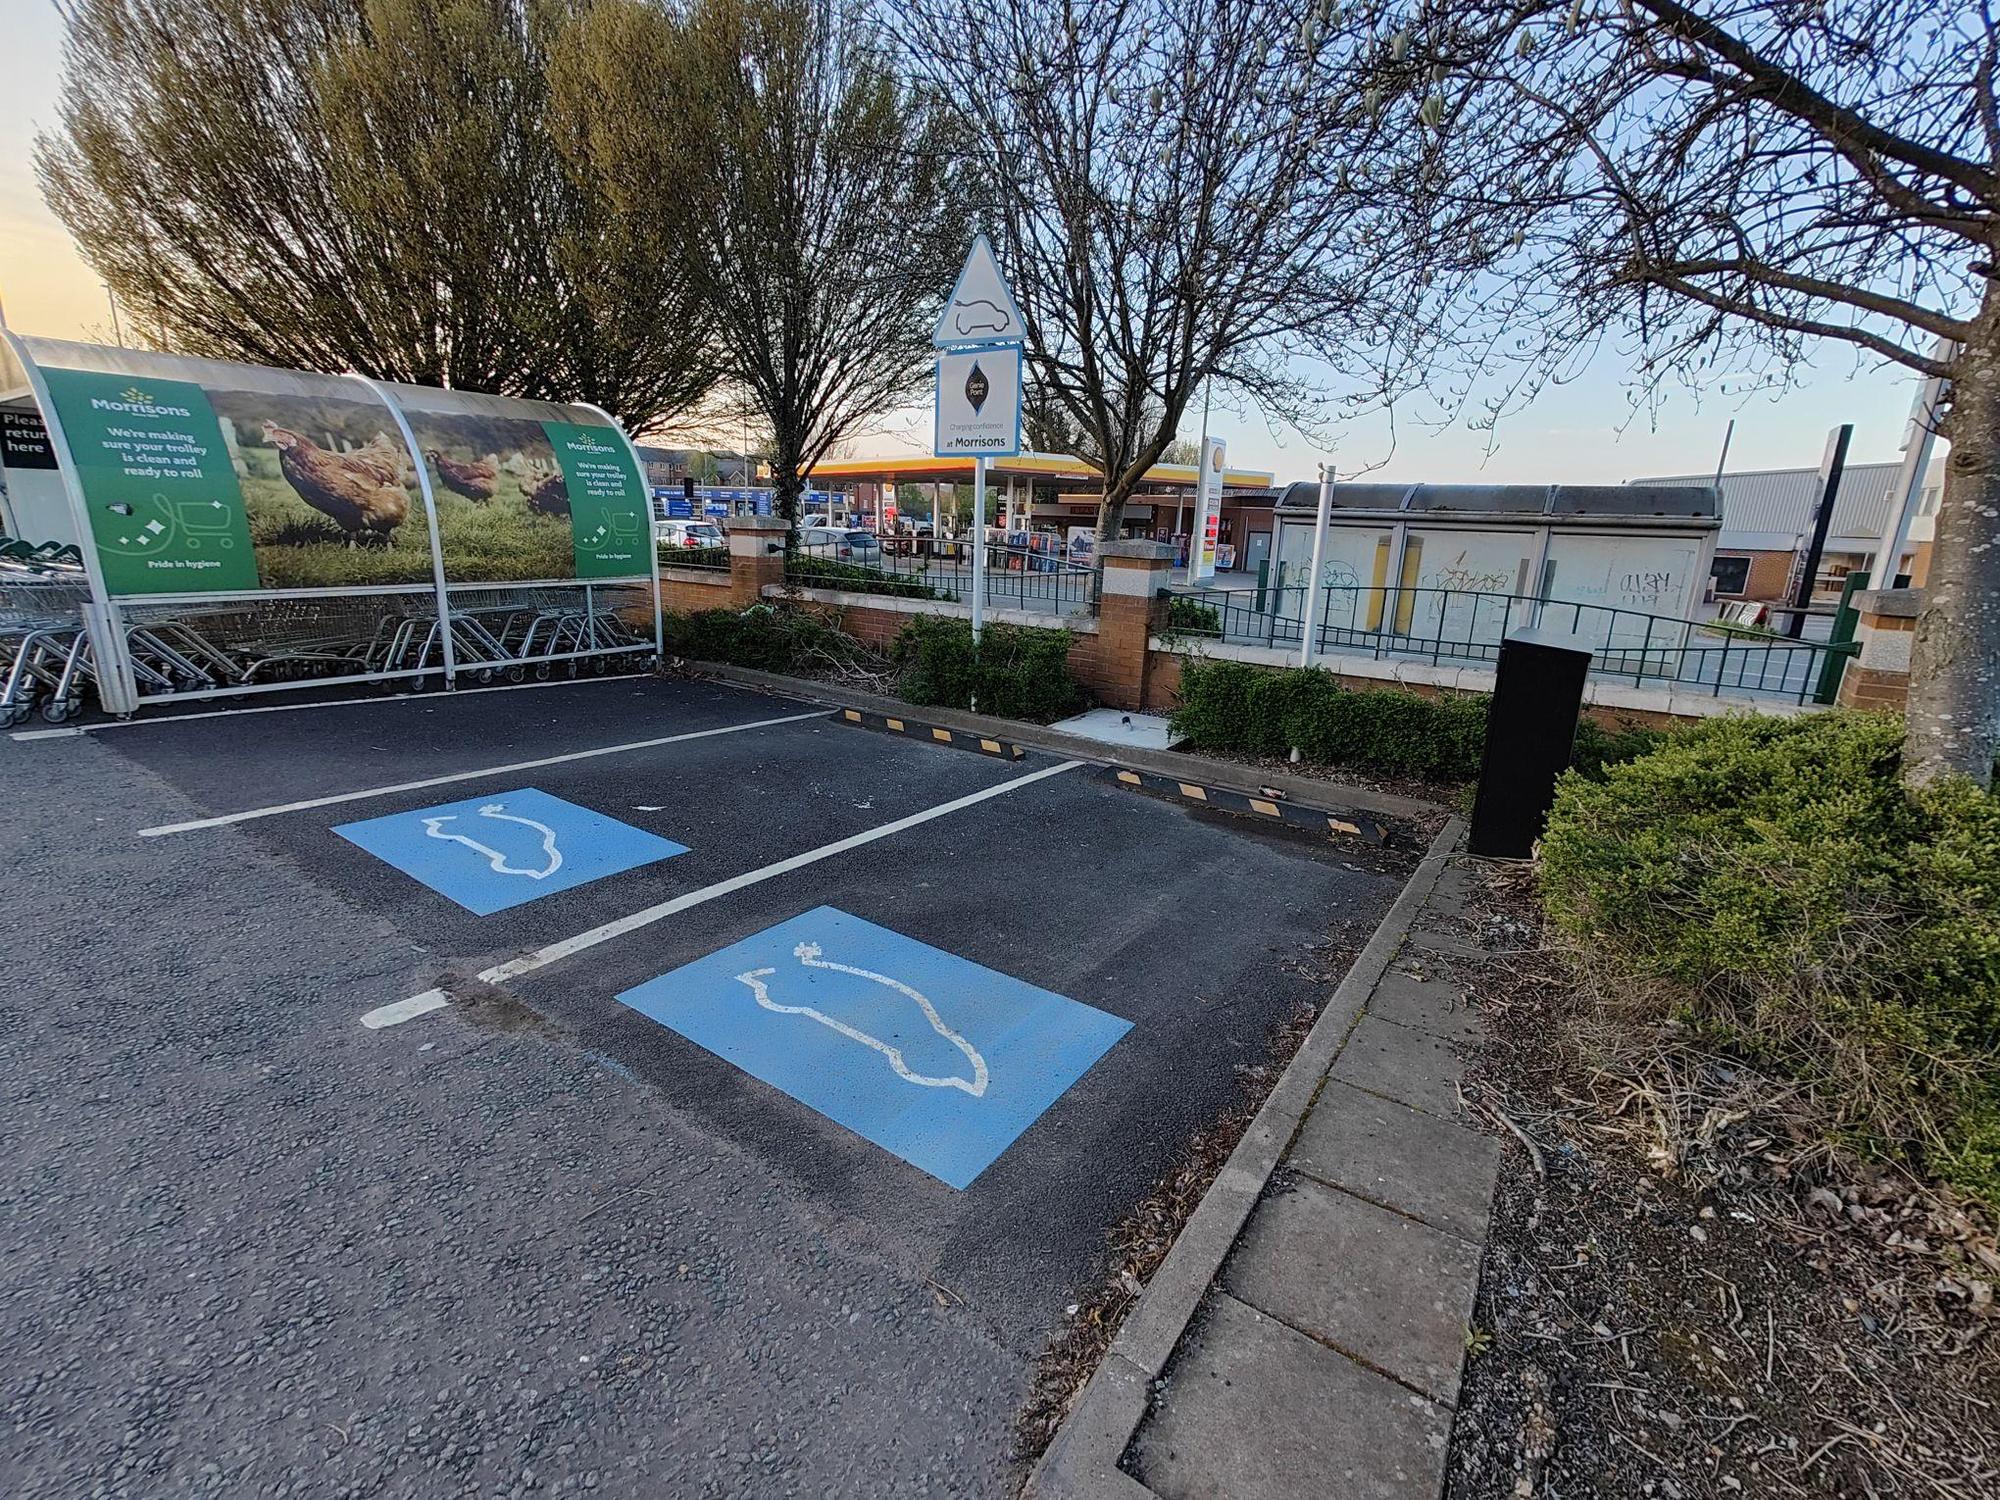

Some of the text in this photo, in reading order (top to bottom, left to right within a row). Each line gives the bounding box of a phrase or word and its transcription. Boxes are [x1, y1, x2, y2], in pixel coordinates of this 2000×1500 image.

[91, 399, 191, 417] Morrisons
[3, 414, 46, 426] Pleas
[5, 429, 48, 439] retur
[107, 427, 195, 444] We're making
[7, 439, 45, 452] here
[955, 434, 1006, 447] Morrisons
[102, 440, 207, 456] sure your trolley
[566, 442, 615, 453] Morrisons
[122, 452, 197, 466] is clean and
[124, 466, 203, 479] ready to roll
[597, 464, 621, 472] making
[606, 472, 627, 480] trolley
[587, 488, 606, 497] ready
[147, 560, 221, 569] Pride in hygiene
